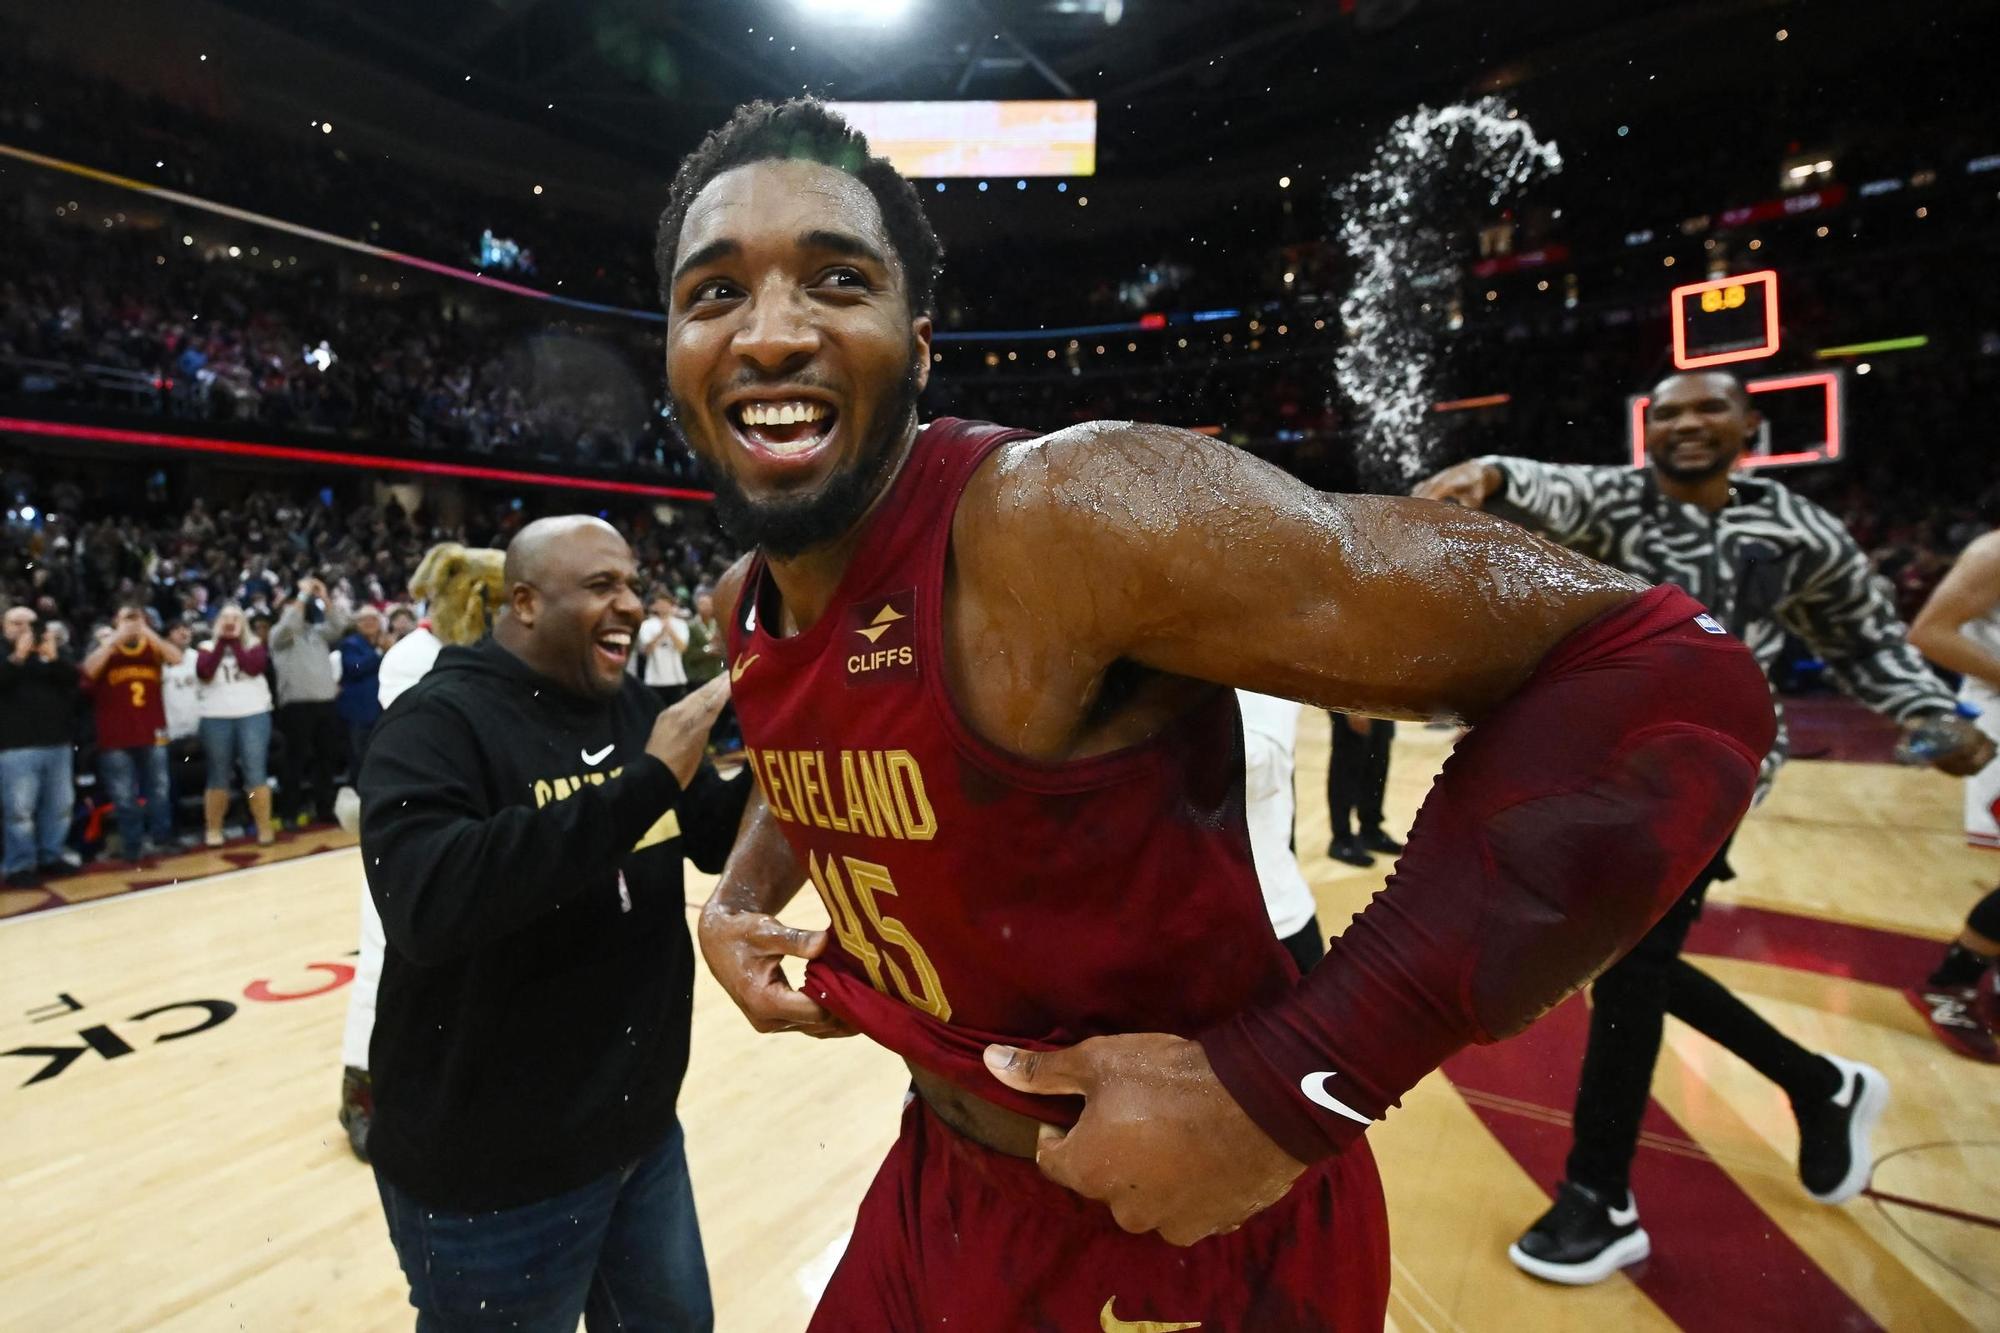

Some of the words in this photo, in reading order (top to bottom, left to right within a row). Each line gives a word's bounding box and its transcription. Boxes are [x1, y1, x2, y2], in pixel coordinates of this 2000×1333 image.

[847, 646, 913, 674] CLIFFS
[130, 681, 146, 707] 2
[745, 748, 938, 841] LEVELAND
[809, 849, 952, 1023] 45
